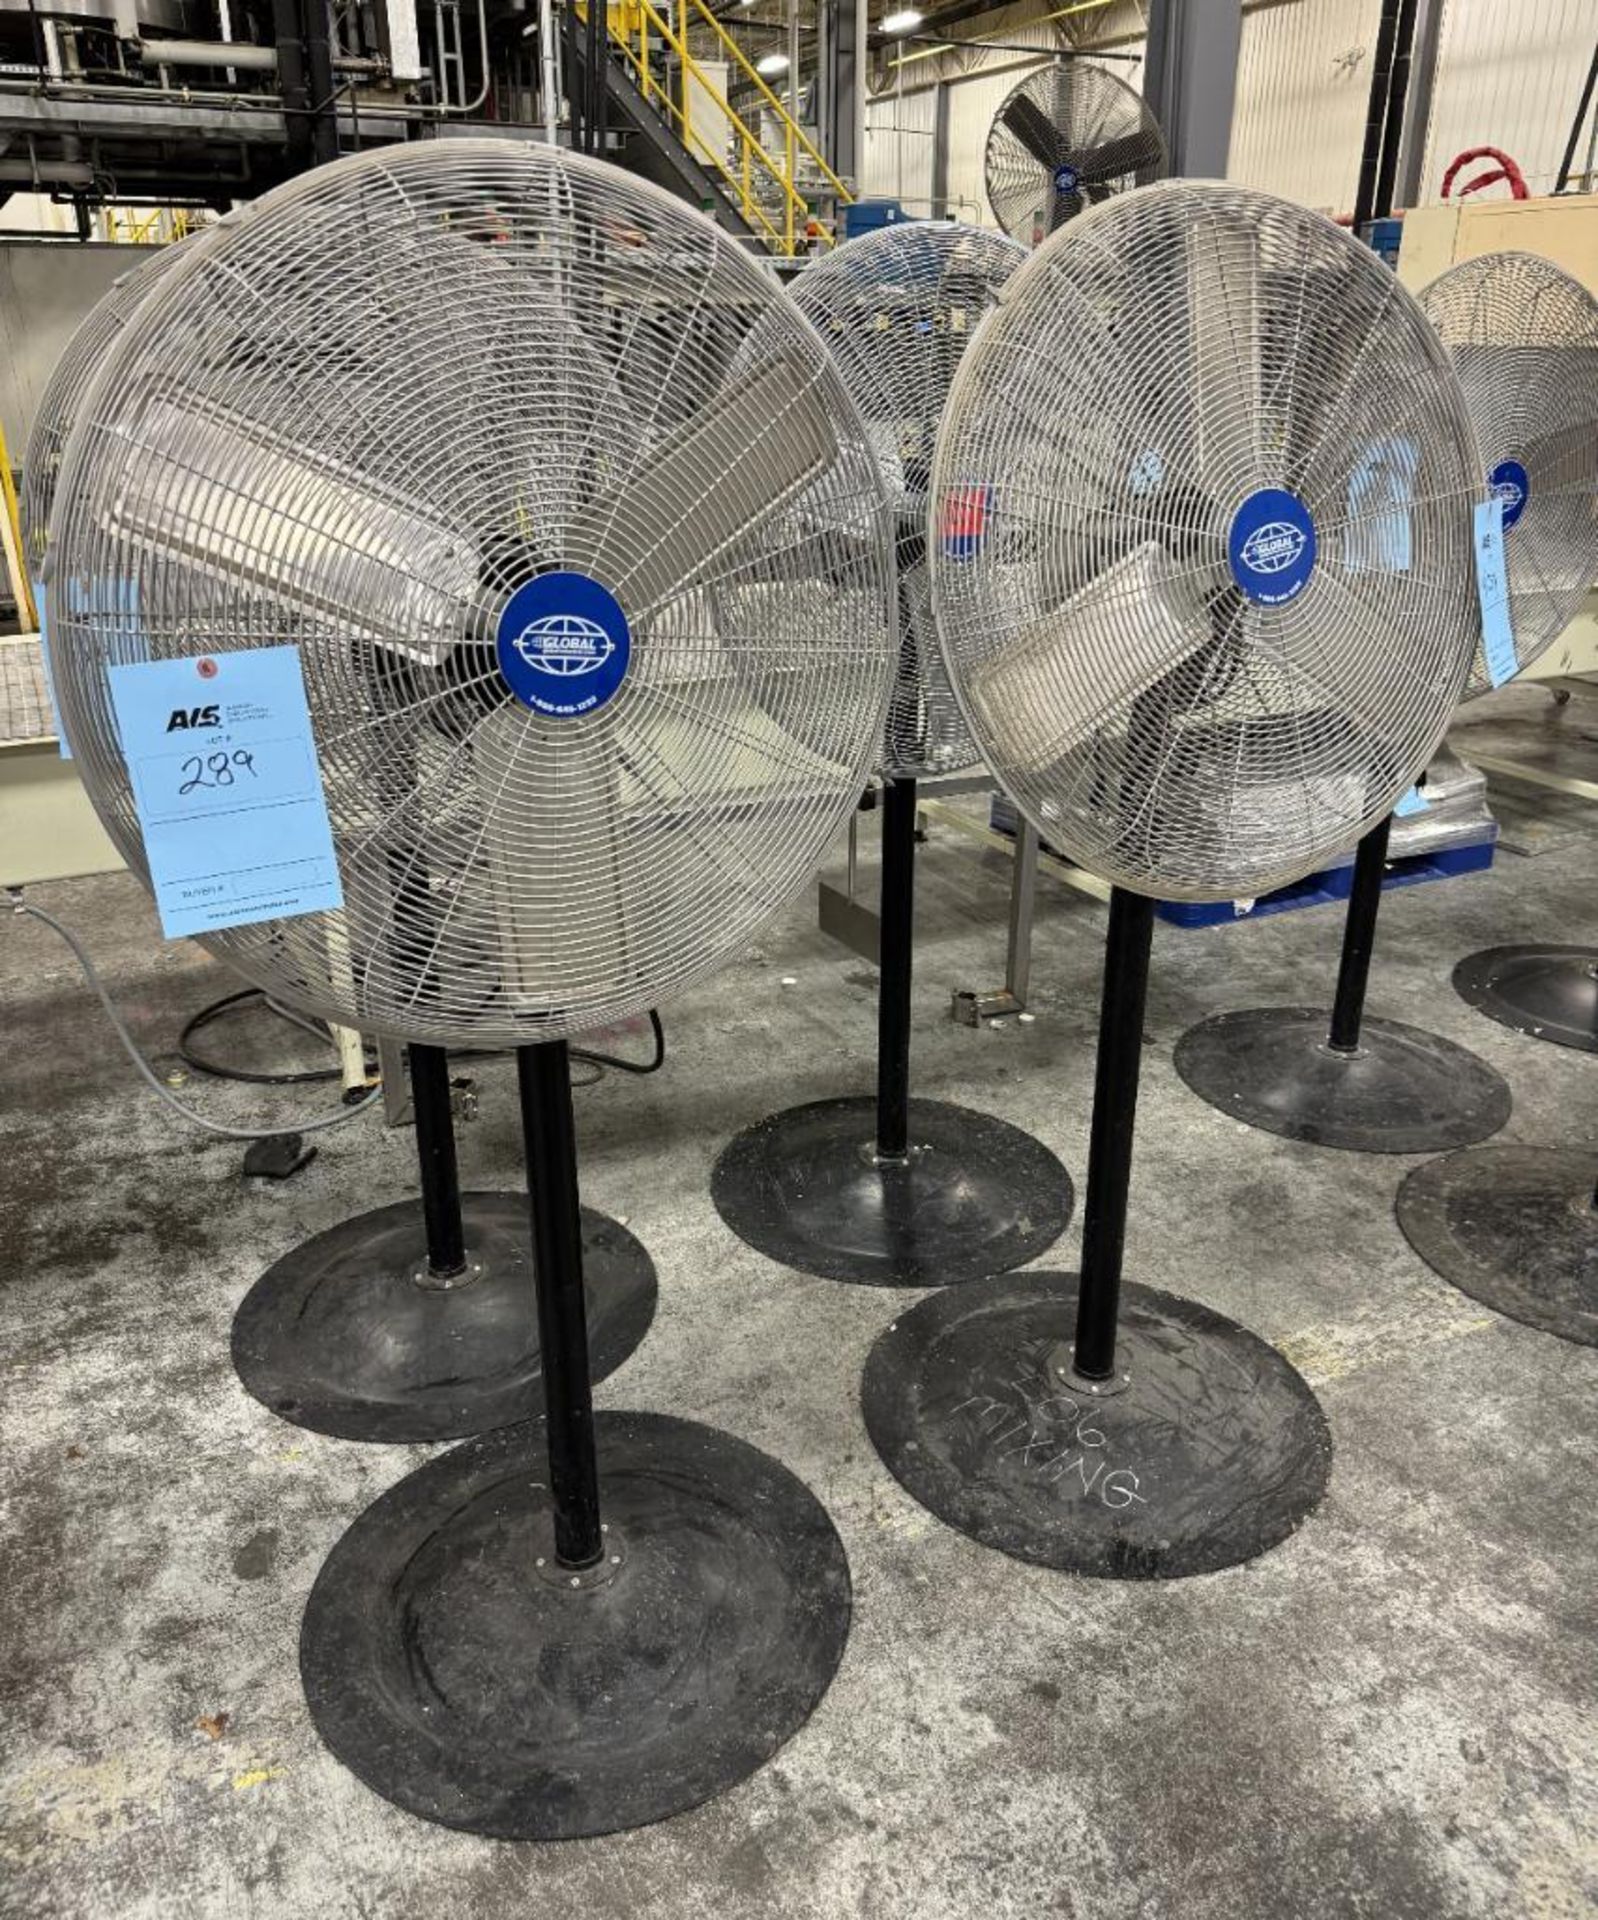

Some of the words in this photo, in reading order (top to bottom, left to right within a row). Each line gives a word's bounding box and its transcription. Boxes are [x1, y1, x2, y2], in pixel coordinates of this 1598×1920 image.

[542, 636, 597, 649] GLOBAL
[166, 704, 221, 732] AIS
[179, 750, 257, 794] 289
